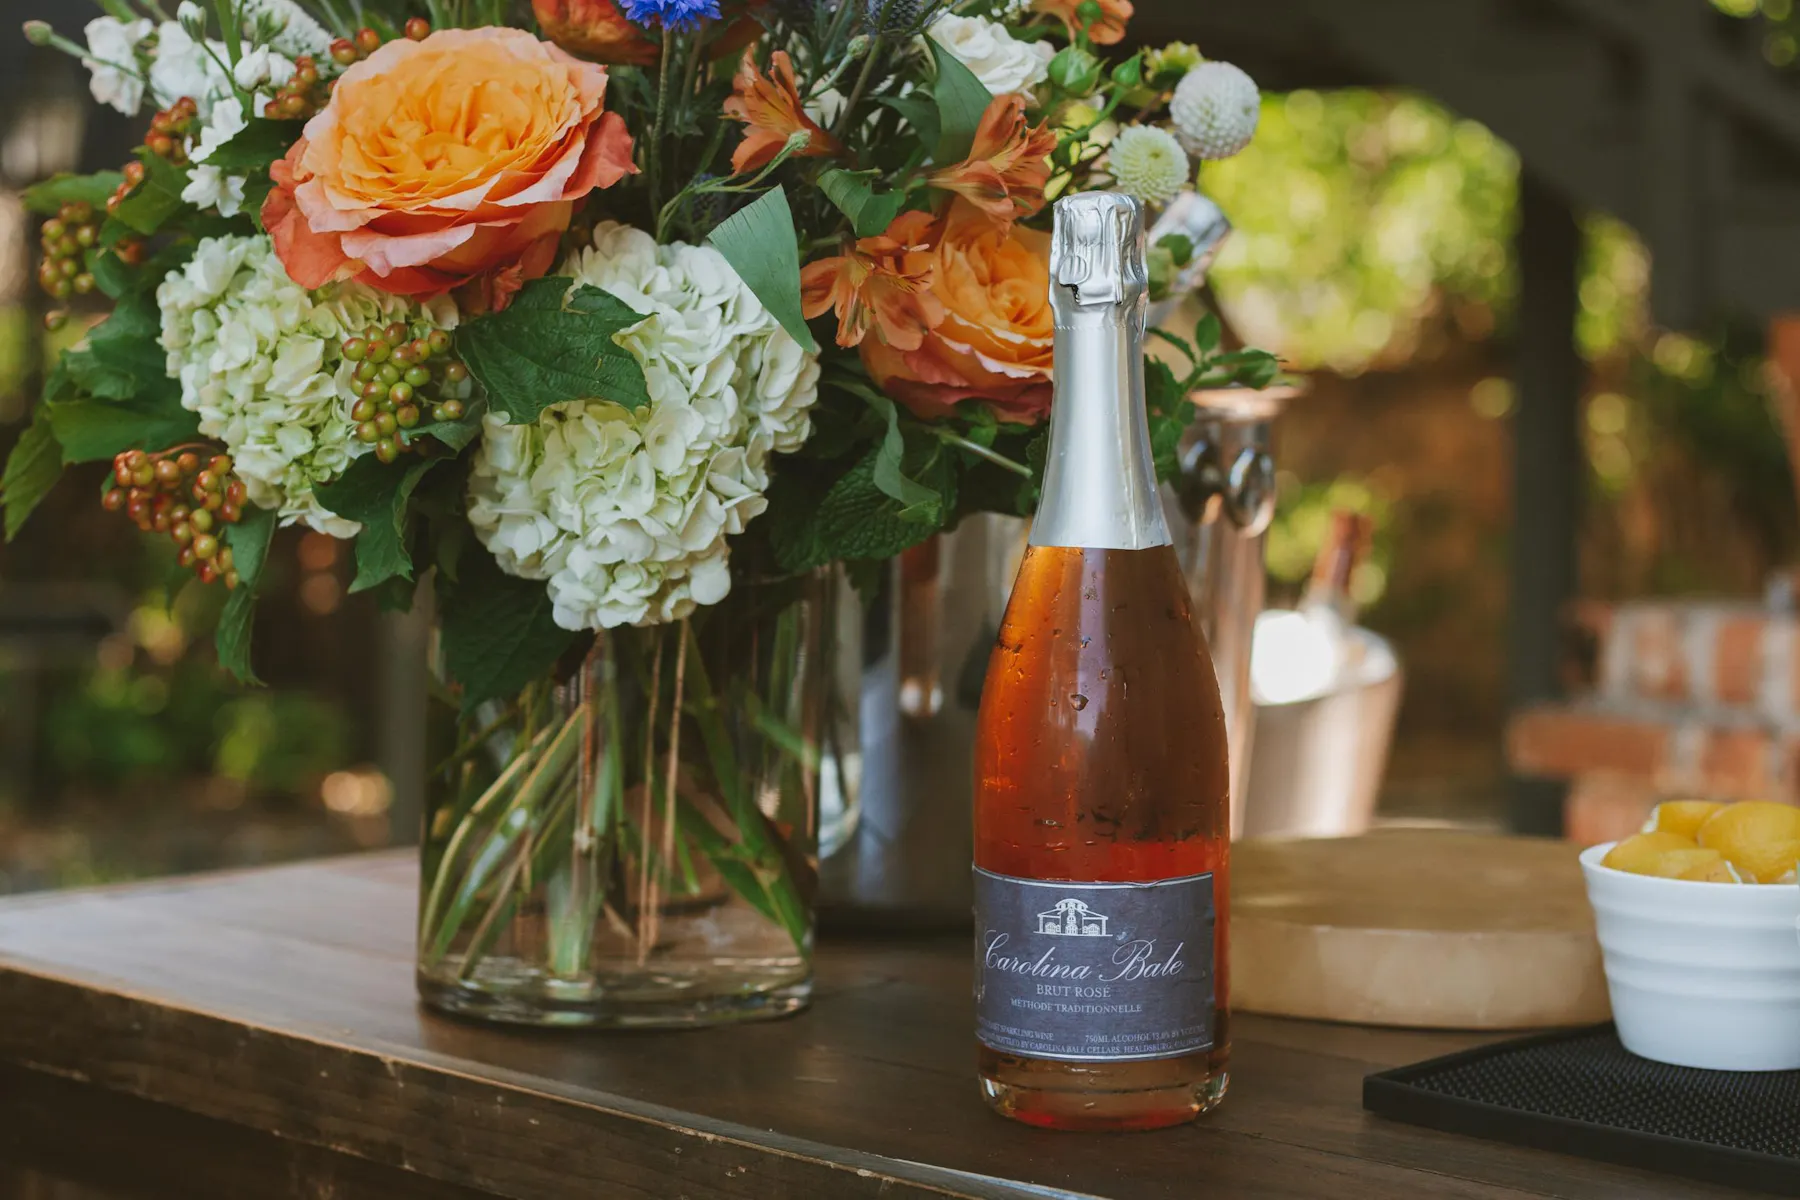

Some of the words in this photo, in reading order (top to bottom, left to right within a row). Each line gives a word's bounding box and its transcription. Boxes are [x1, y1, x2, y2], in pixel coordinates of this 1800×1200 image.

[985, 930, 1093, 980] Carolina
[1099, 938, 1184, 982] Bale
[1036, 984, 1071, 997] BRUT
[1075, 984, 1111, 998] ROSÉ
[1055, 1003, 1142, 1013] TRADITIONNELLE
[1085, 1034, 1109, 1043] 750ML
[1111, 1031, 1151, 1043] ALCOHOL
[1029, 1042, 1066, 1053] CAROLINA
[1066, 1045, 1085, 1053] BALE
